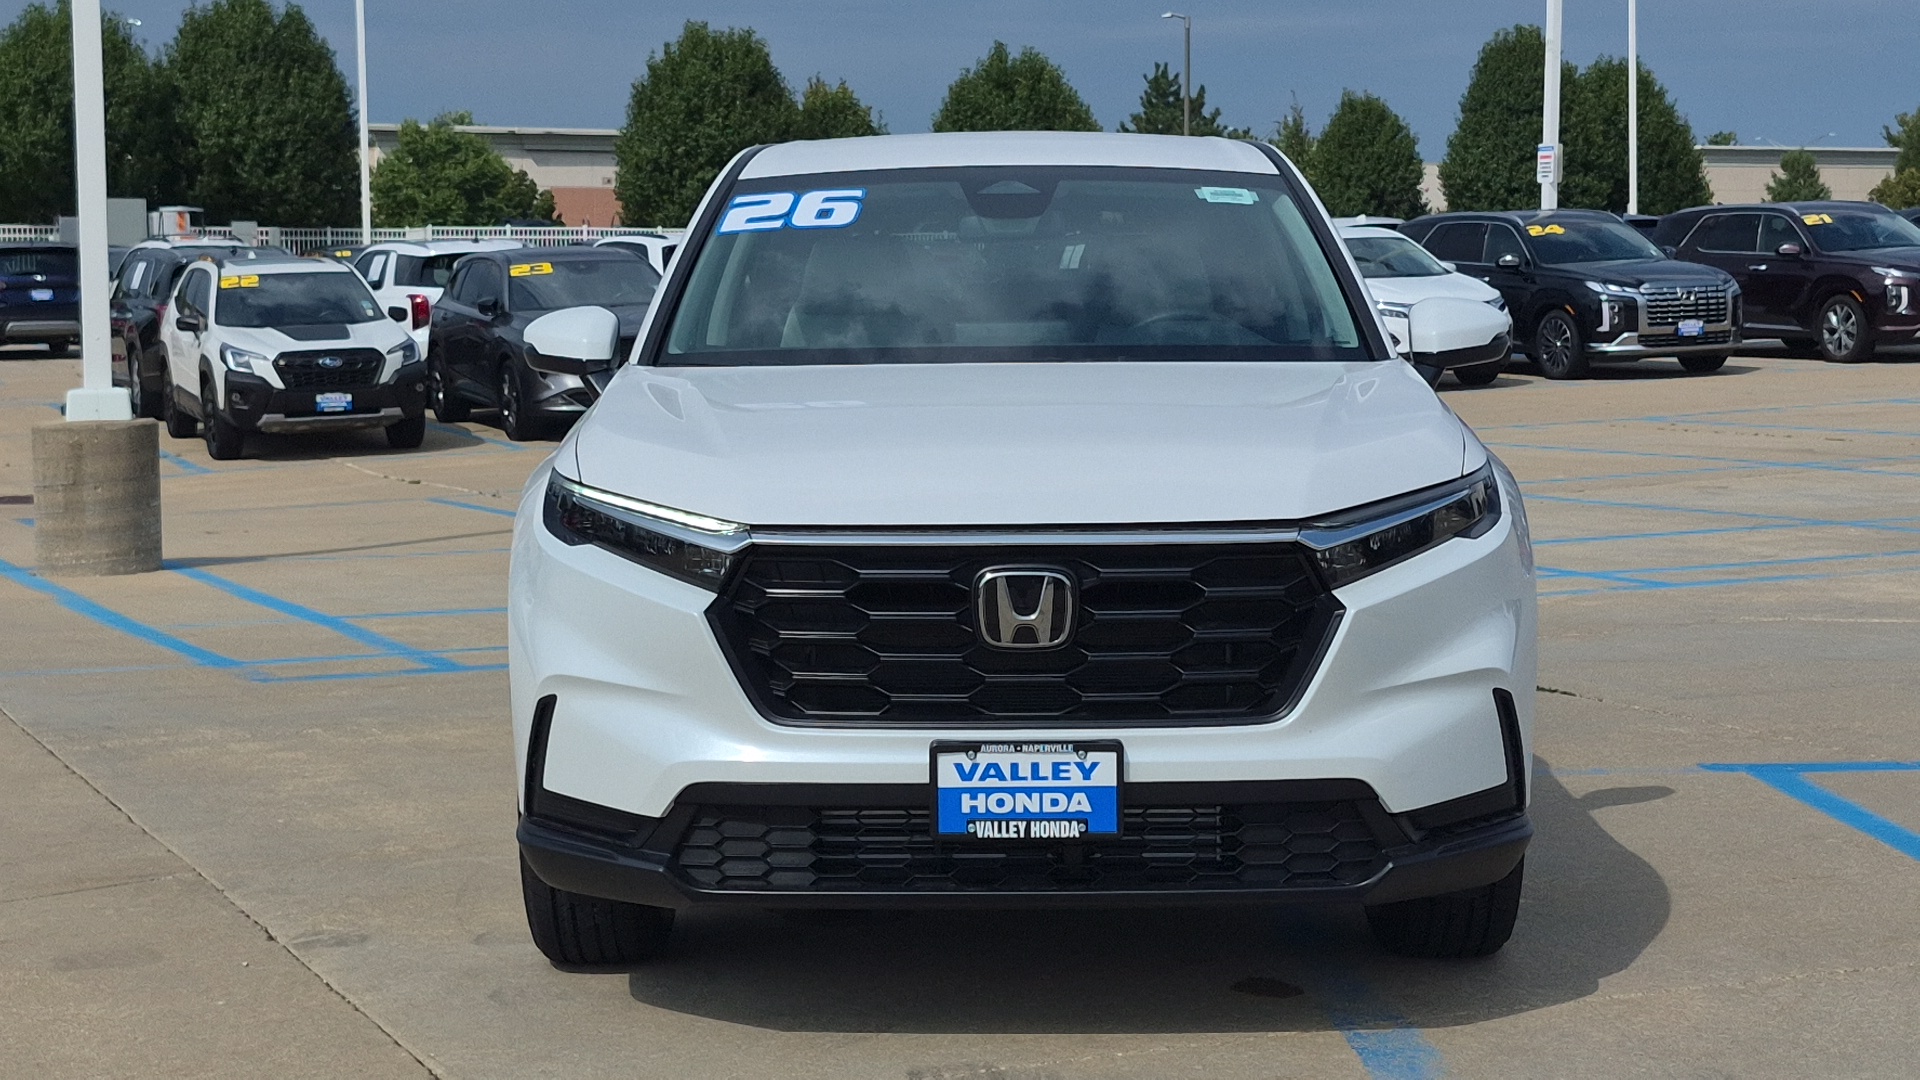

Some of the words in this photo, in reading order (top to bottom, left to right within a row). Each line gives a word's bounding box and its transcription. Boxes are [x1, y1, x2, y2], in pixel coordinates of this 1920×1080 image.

[718, 187, 867, 235] 26
[1800, 213, 1834, 226] 21
[1525, 223, 1566, 237] 24
[509, 261, 554, 277] 23
[219, 274, 260, 289] 22
[980, 744, 1015, 753] AURORA
[1022, 744, 1074, 753] NAPERVILLE
[953, 761, 1101, 782] VALLEY
[961, 792, 1092, 814] HONDA
[975, 820, 1027, 839] VALLEY
[1030, 820, 1080, 839] HONDA
